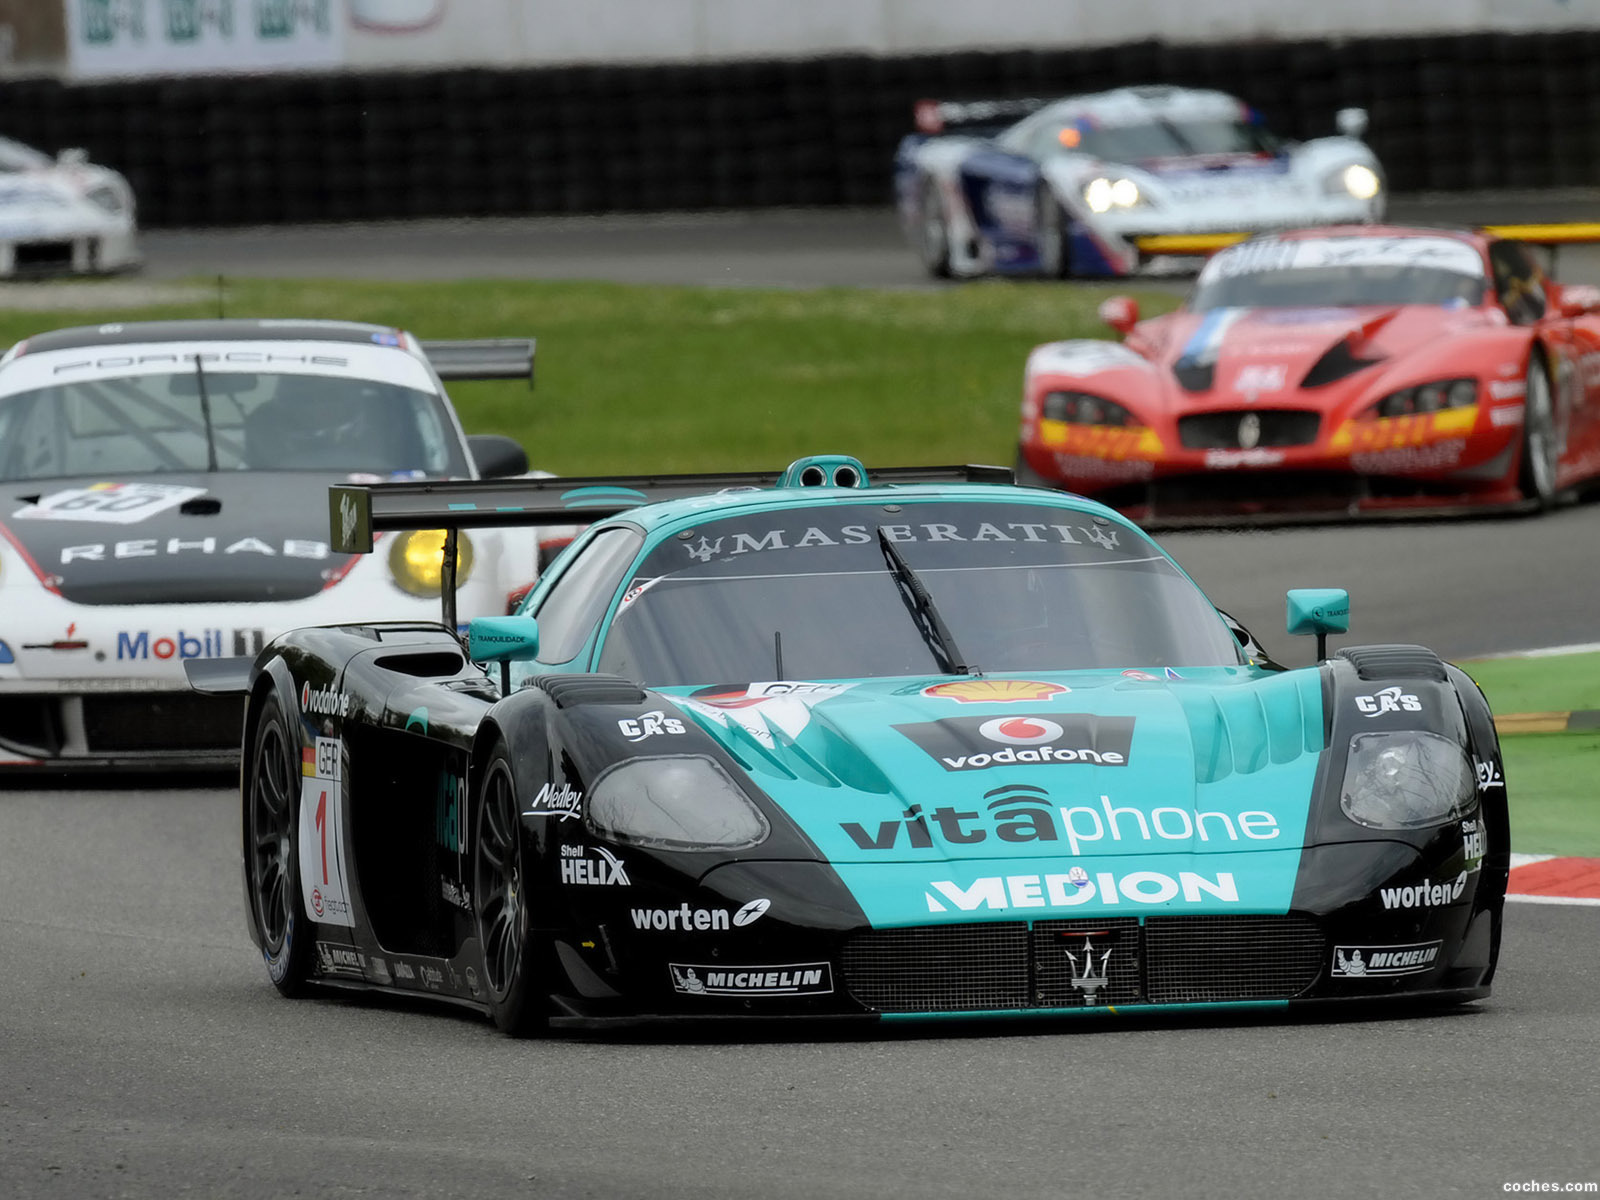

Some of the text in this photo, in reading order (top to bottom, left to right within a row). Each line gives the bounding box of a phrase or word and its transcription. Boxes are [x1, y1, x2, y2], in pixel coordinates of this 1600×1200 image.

[54, 352, 349, 375] PORSCHE
[61, 536, 330, 564] REHAB
[729, 522, 1088, 555] MASERATI
[116, 628, 222, 660] Mobil
[309, 683, 350, 718] vodafone
[1354, 687, 1423, 717] CAS
[618, 712, 687, 741] CAS
[318, 741, 339, 776] GER
[942, 745, 1124, 769] vodafone
[838, 790, 1281, 856] vitaphone
[315, 791, 328, 886] 1
[561, 844, 584, 857] Shell
[561, 857, 632, 886] HELIX
[925, 871, 1240, 913] MEDION
[1380, 878, 1451, 909] worten
[631, 902, 730, 931] worten
[1368, 946, 1439, 968] MICHELIN
[706, 969, 823, 988] MICHELIN
